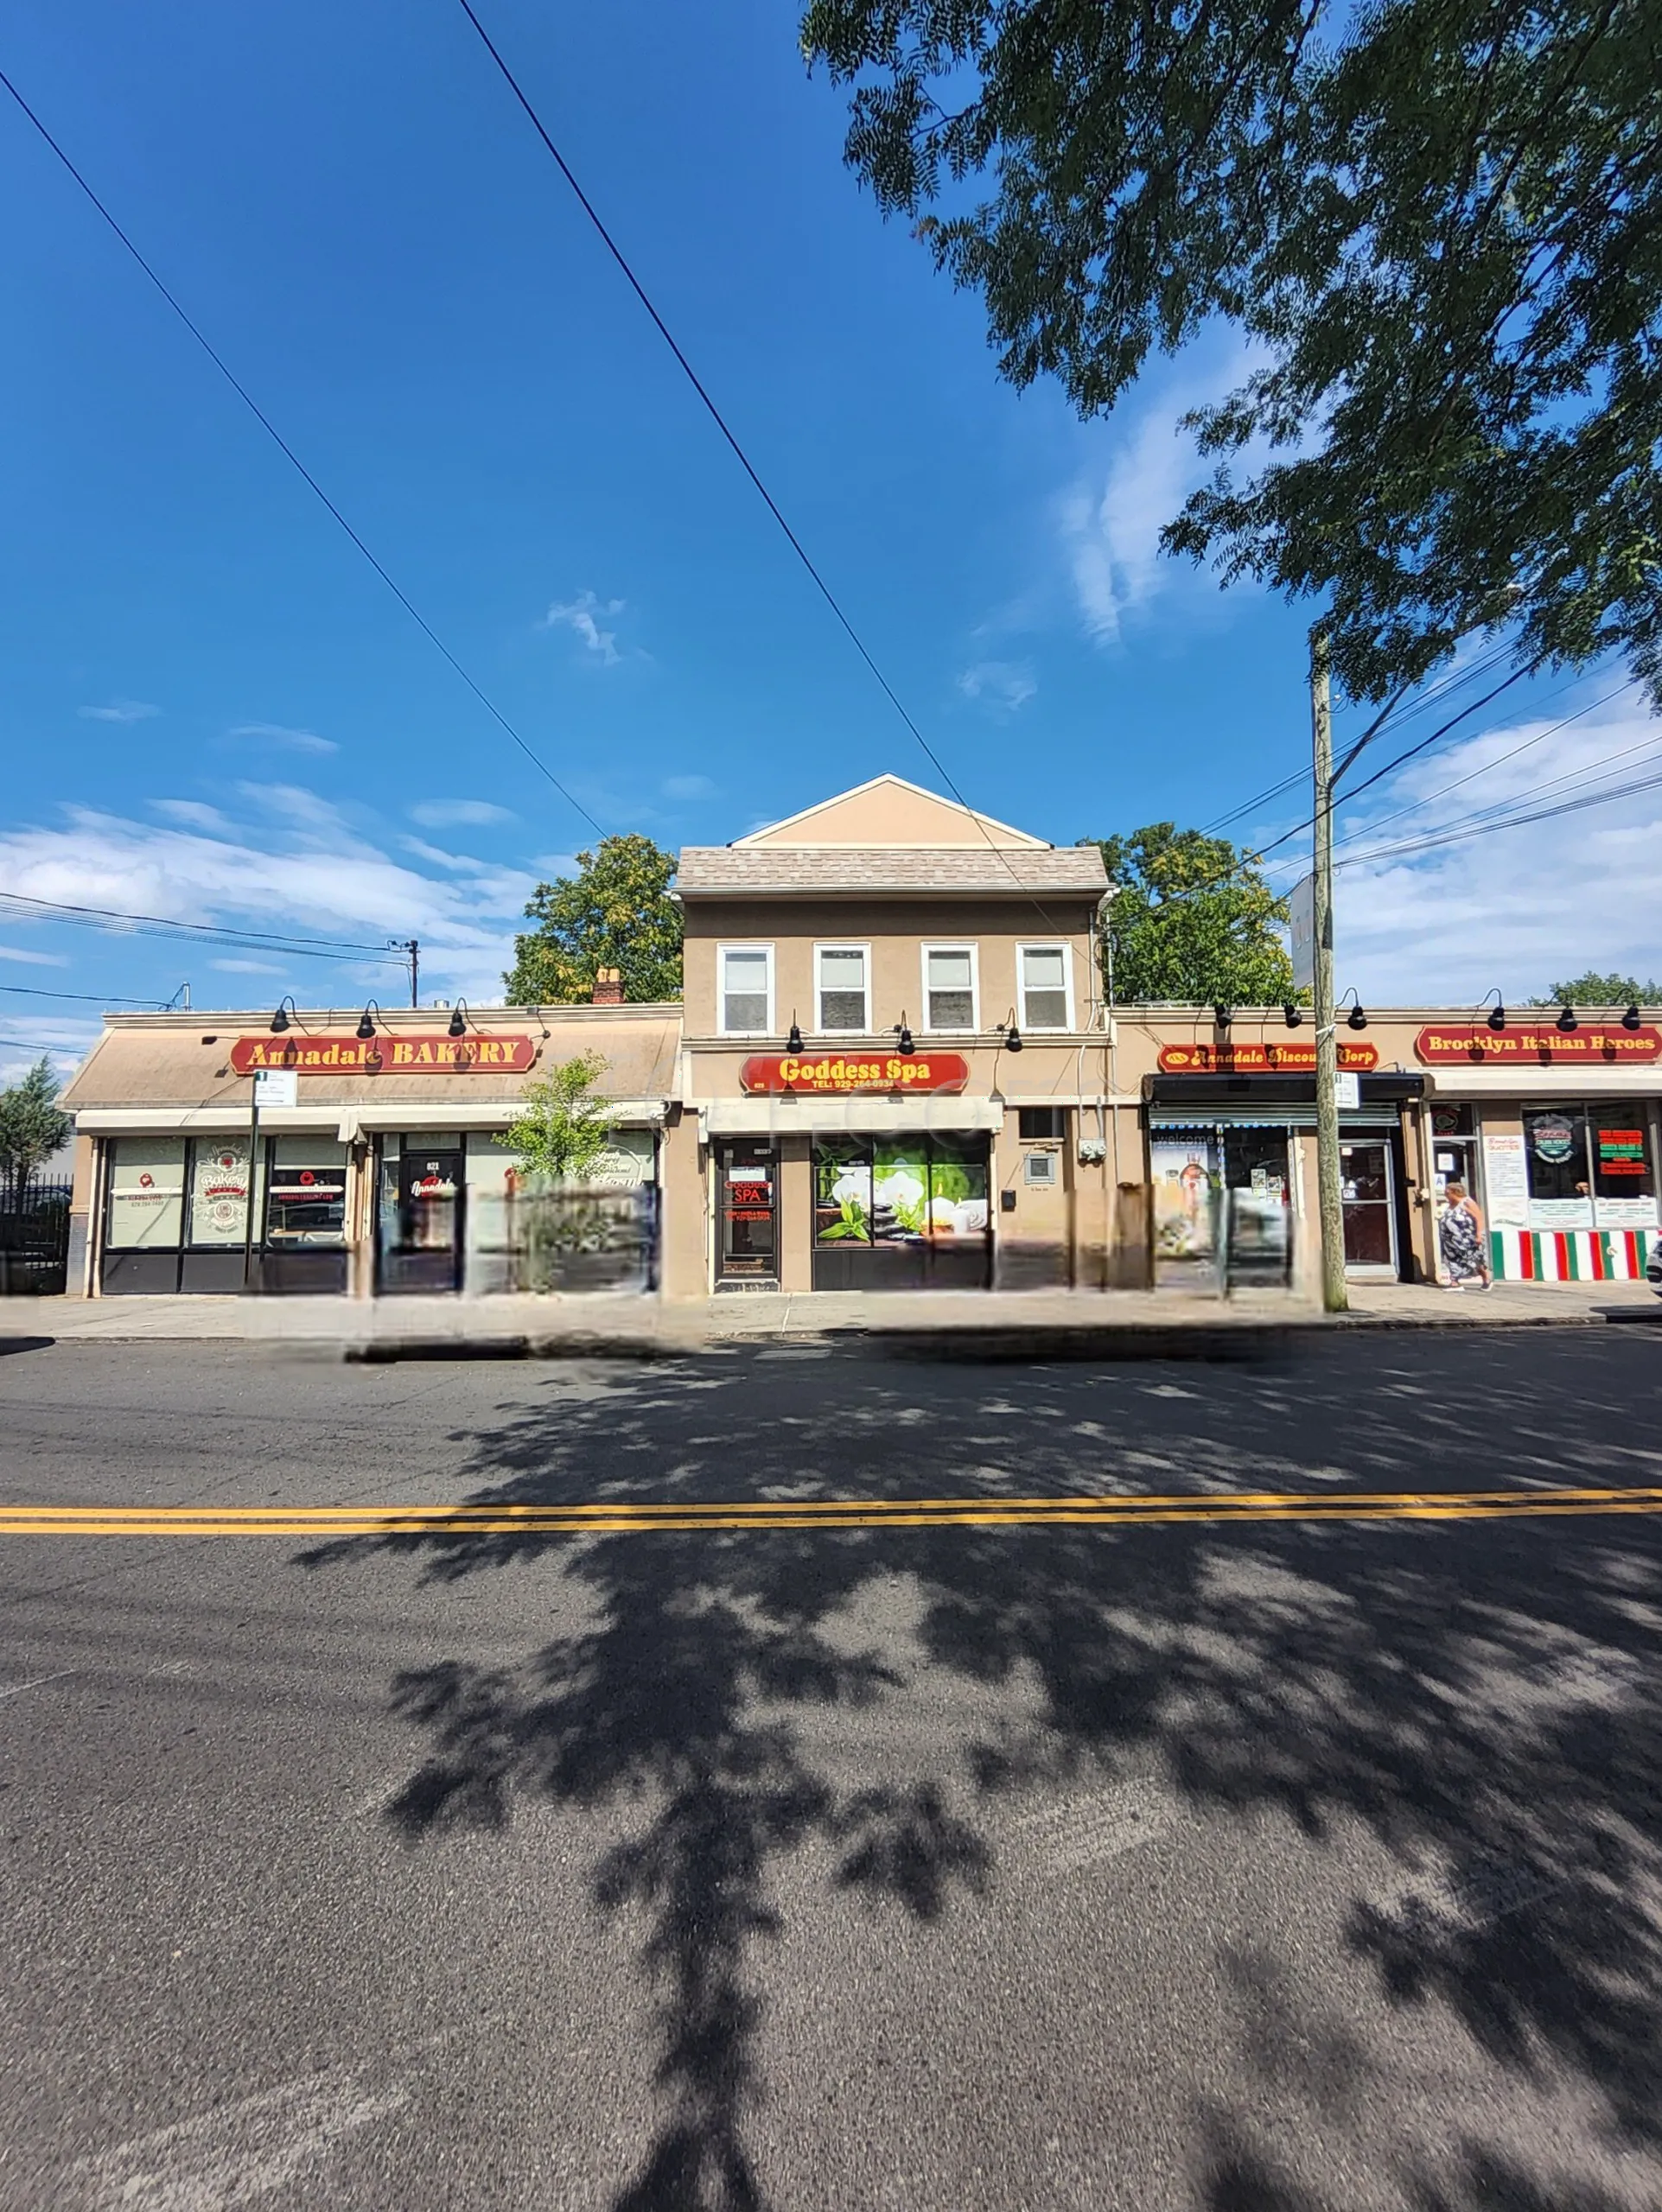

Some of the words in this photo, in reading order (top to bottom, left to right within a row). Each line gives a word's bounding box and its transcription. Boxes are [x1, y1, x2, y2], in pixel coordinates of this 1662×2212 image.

[246, 1044, 382, 1065] Annadale
[392, 1041, 520, 1064] BAKERY
[1429, 1035, 1517, 1053] Brooklyn
[1521, 1035, 1586, 1049] Italian
[1589, 1035, 1655, 1049] Heroes
[1191, 1048, 1264, 1065] Annadale
[1268, 1047, 1316, 1063] Discou
[780, 1058, 880, 1081] Goddess
[887, 1058, 931, 1083] Spa
[1156, 1133, 1214, 1145] welcome
[426, 1161, 439, 1171] 821
[735, 1189, 761, 1202] SPA
